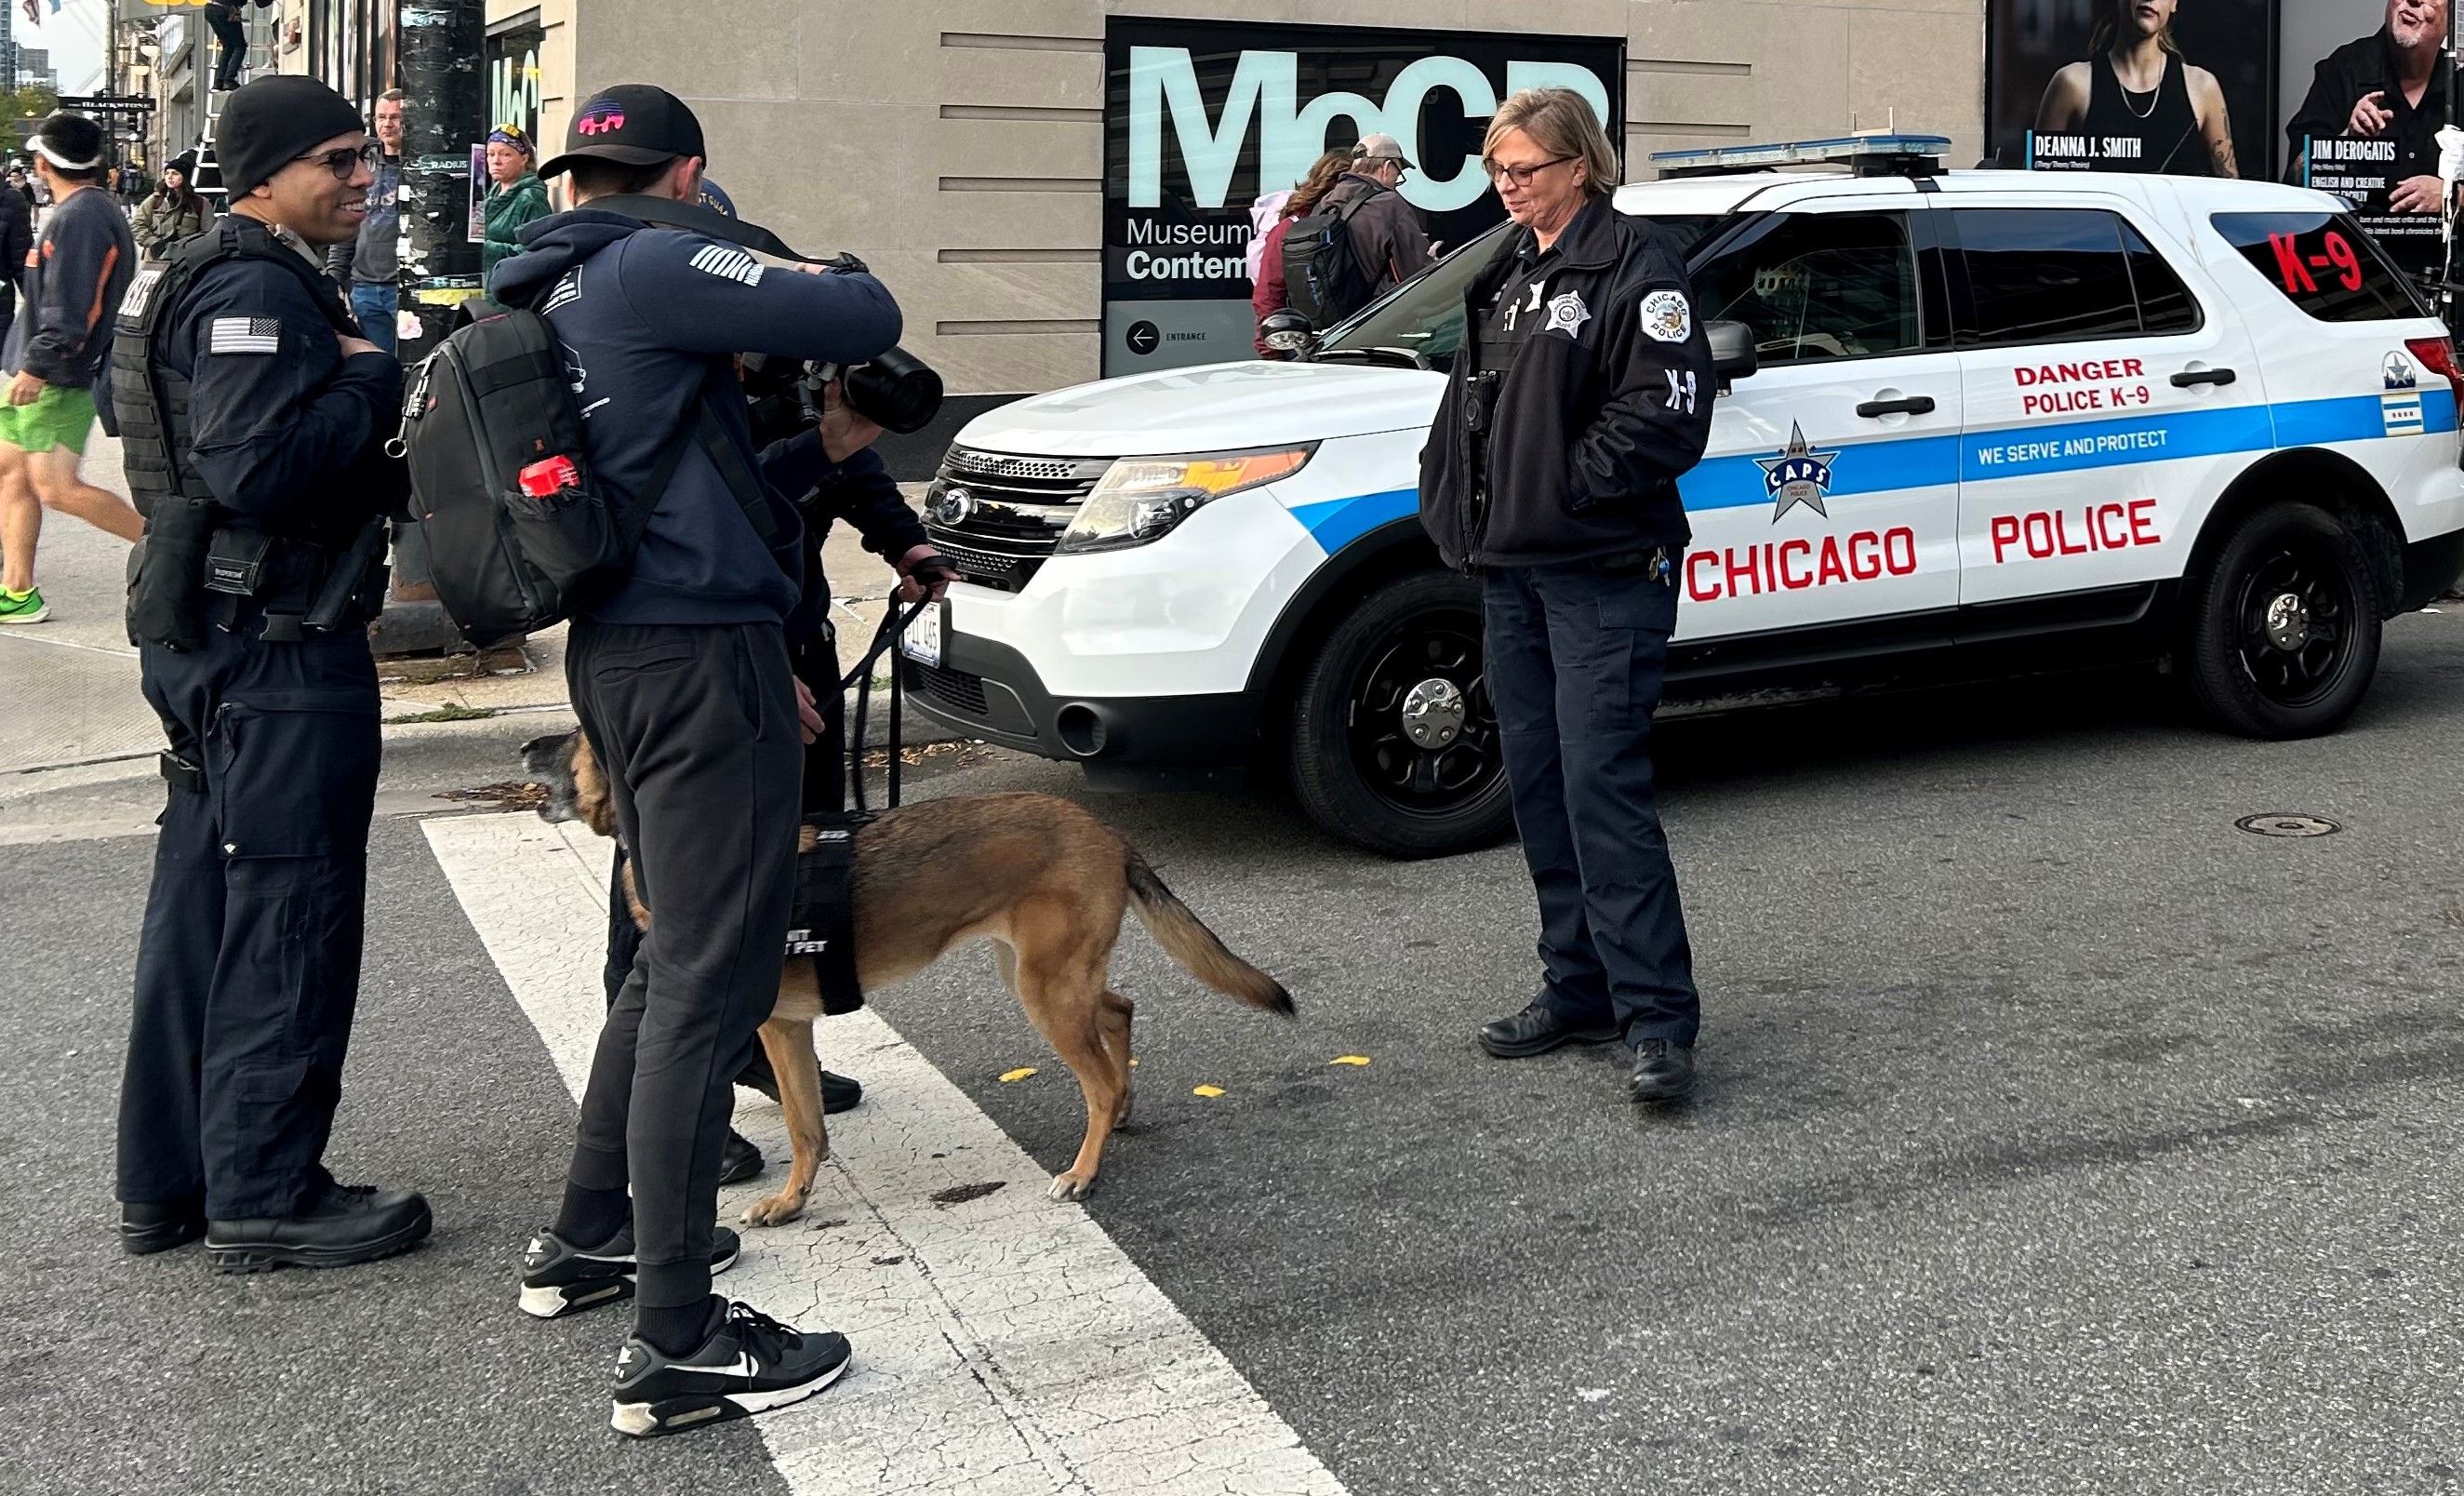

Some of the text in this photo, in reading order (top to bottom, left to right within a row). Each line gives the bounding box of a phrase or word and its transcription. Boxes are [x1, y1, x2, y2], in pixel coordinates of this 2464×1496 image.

[2035, 136, 2141, 158] DEANNA J. SMITH
[2311, 140, 2395, 161] JIM DEROGATIS
[432, 160, 468, 169] RADIUS
[2340, 177, 2354, 189] AND
[2355, 177, 2386, 189] CREATIVE
[1126, 218, 1252, 245] Museum
[2268, 232, 2362, 293] K-9
[1646, 293, 1688, 316] CHICAGO
[1165, 331, 1206, 341] ENTRANCE
[1650, 322, 1686, 340] POLICE
[2013, 358, 2145, 386] DANGER
[1664, 368, 1697, 415] K-9
[2023, 385, 2150, 415] POLICE K-9
[1978, 430, 2168, 465] WE SERVE AND PROTECT
[1769, 462, 1828, 488] CAPS
[1991, 498, 2161, 564] POLICE
[1685, 527, 1917, 603] CHICAGO
[793, 941, 827, 954] PET
